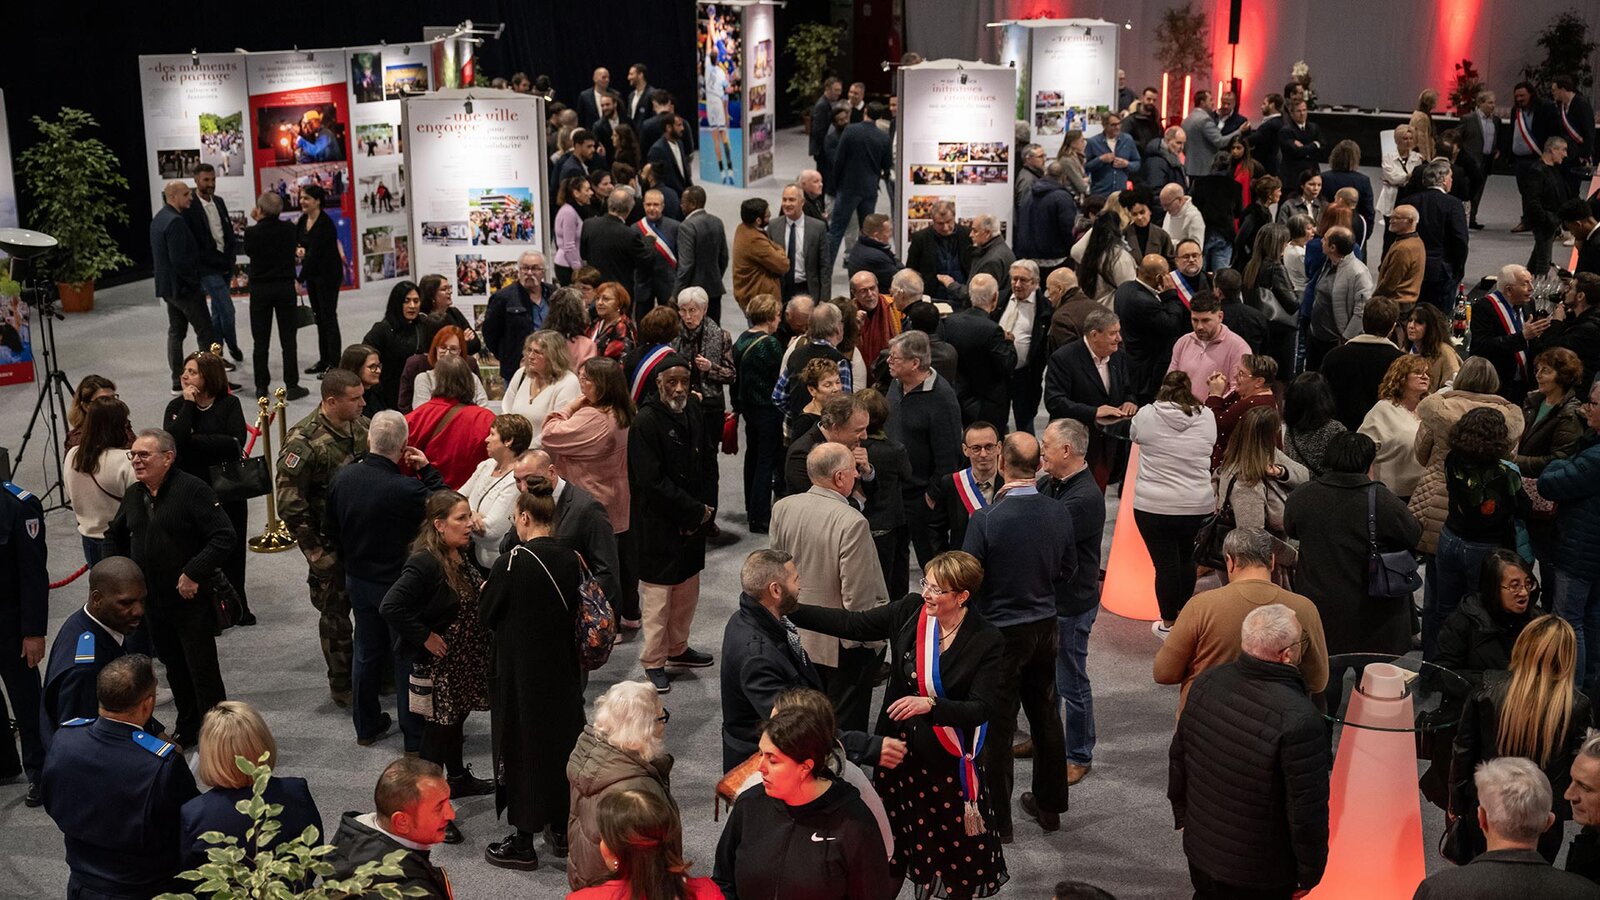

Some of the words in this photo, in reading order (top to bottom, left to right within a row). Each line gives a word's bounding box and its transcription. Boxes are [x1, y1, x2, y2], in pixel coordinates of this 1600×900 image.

[179, 63, 238, 72] moments
[161, 72, 177, 82] de
[180, 72, 231, 86] partage
[485, 107, 519, 121] ville
[450, 224, 468, 238] 50
